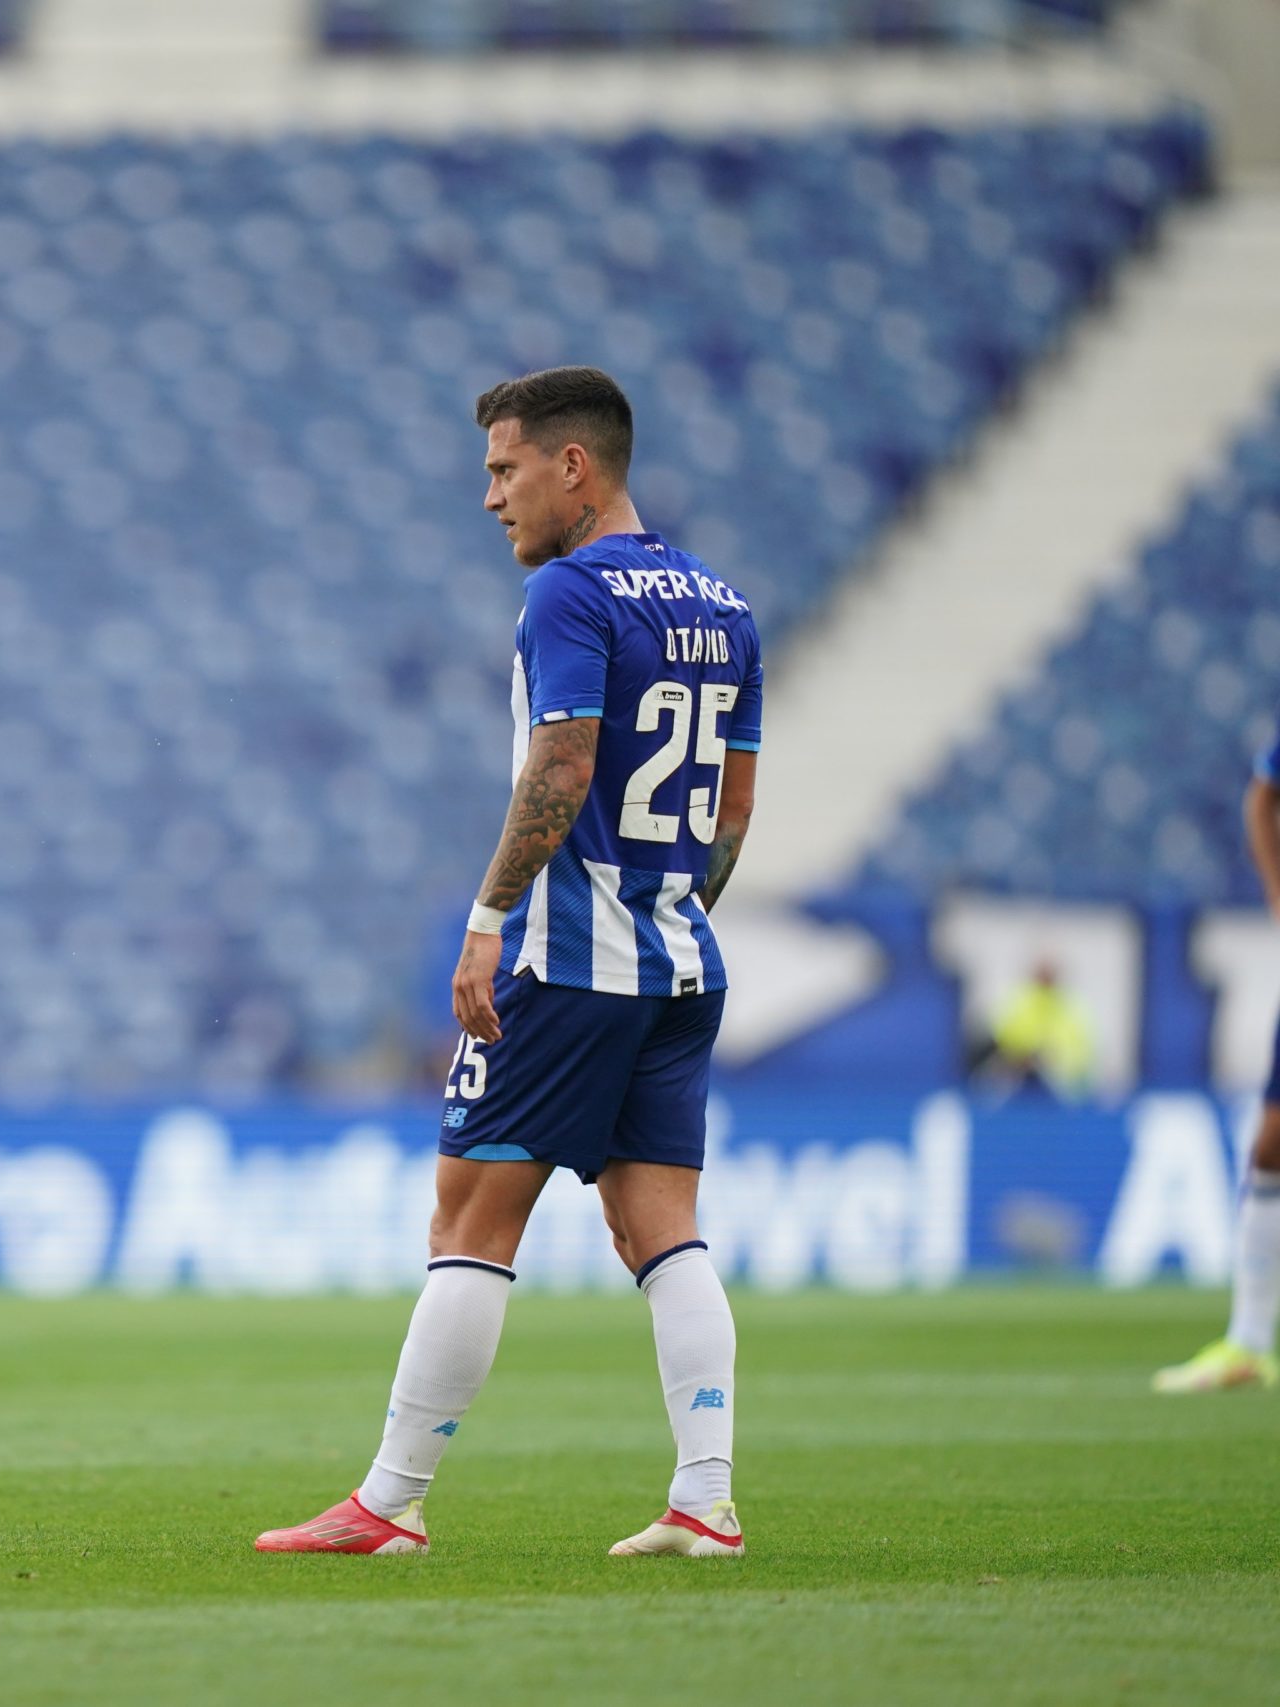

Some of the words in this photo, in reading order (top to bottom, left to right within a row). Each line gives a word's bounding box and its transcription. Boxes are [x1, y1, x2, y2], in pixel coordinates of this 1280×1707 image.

[601, 569, 695, 599] SUPER
[665, 691, 683, 700] bwin
[618, 681, 739, 845] 25
